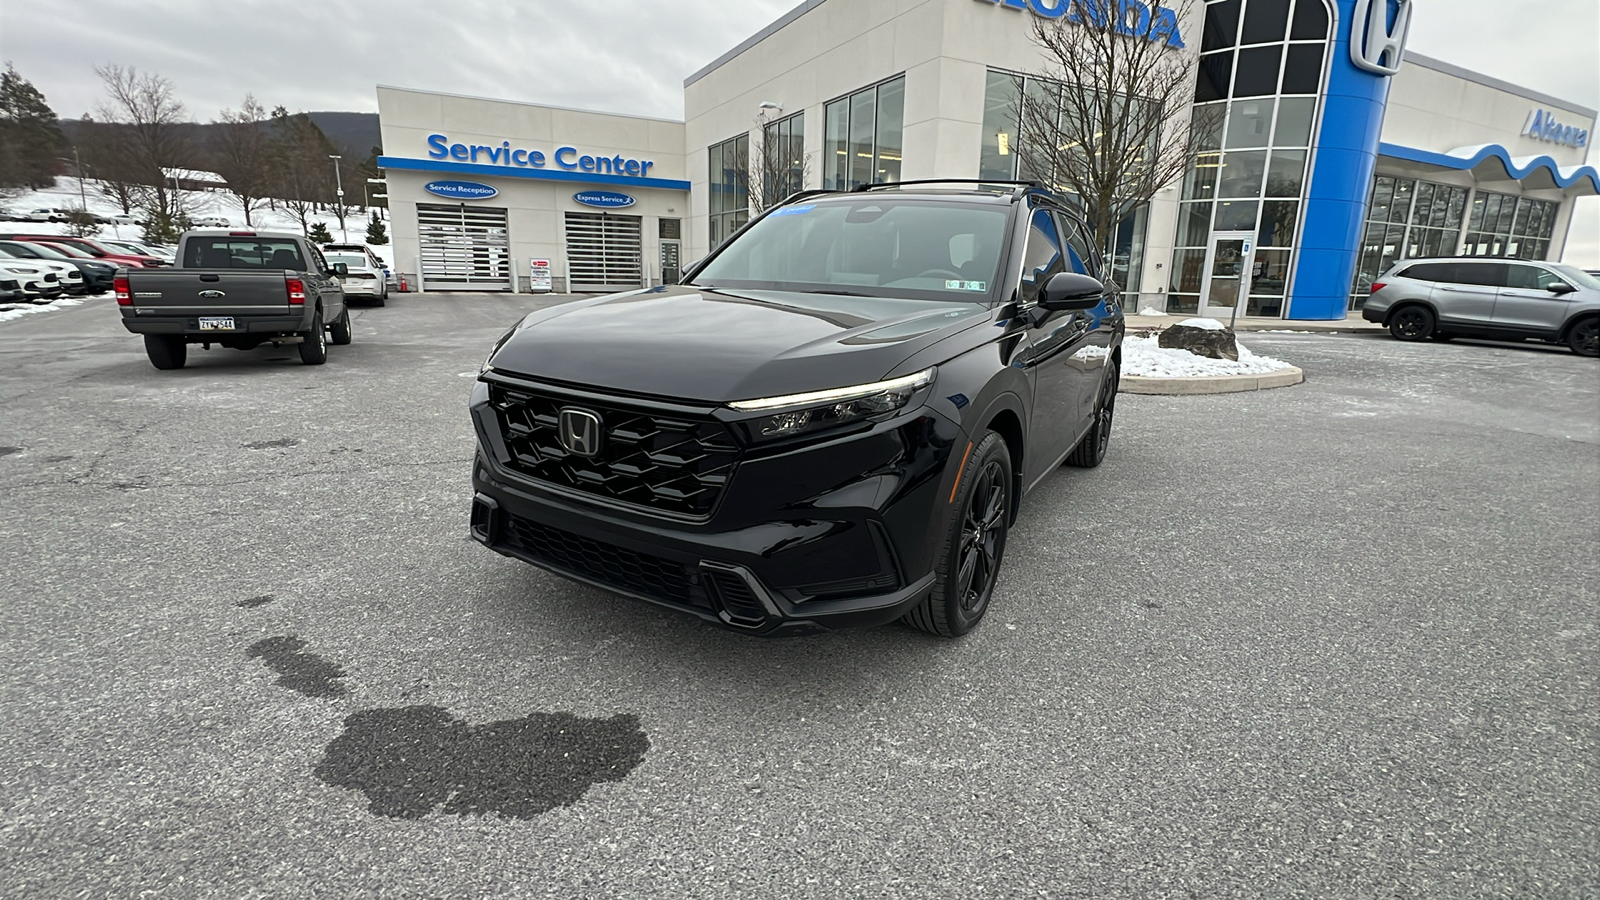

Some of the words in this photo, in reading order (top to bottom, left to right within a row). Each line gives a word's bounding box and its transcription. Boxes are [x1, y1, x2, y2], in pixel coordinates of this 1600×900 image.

[975, 0, 1186, 48] NDA
[427, 133, 546, 167] Service
[554, 146, 654, 177] Center
[429, 183, 457, 192] Service
[458, 185, 494, 195] Reception
[577, 194, 600, 202] Express
[601, 195, 624, 203] Service
